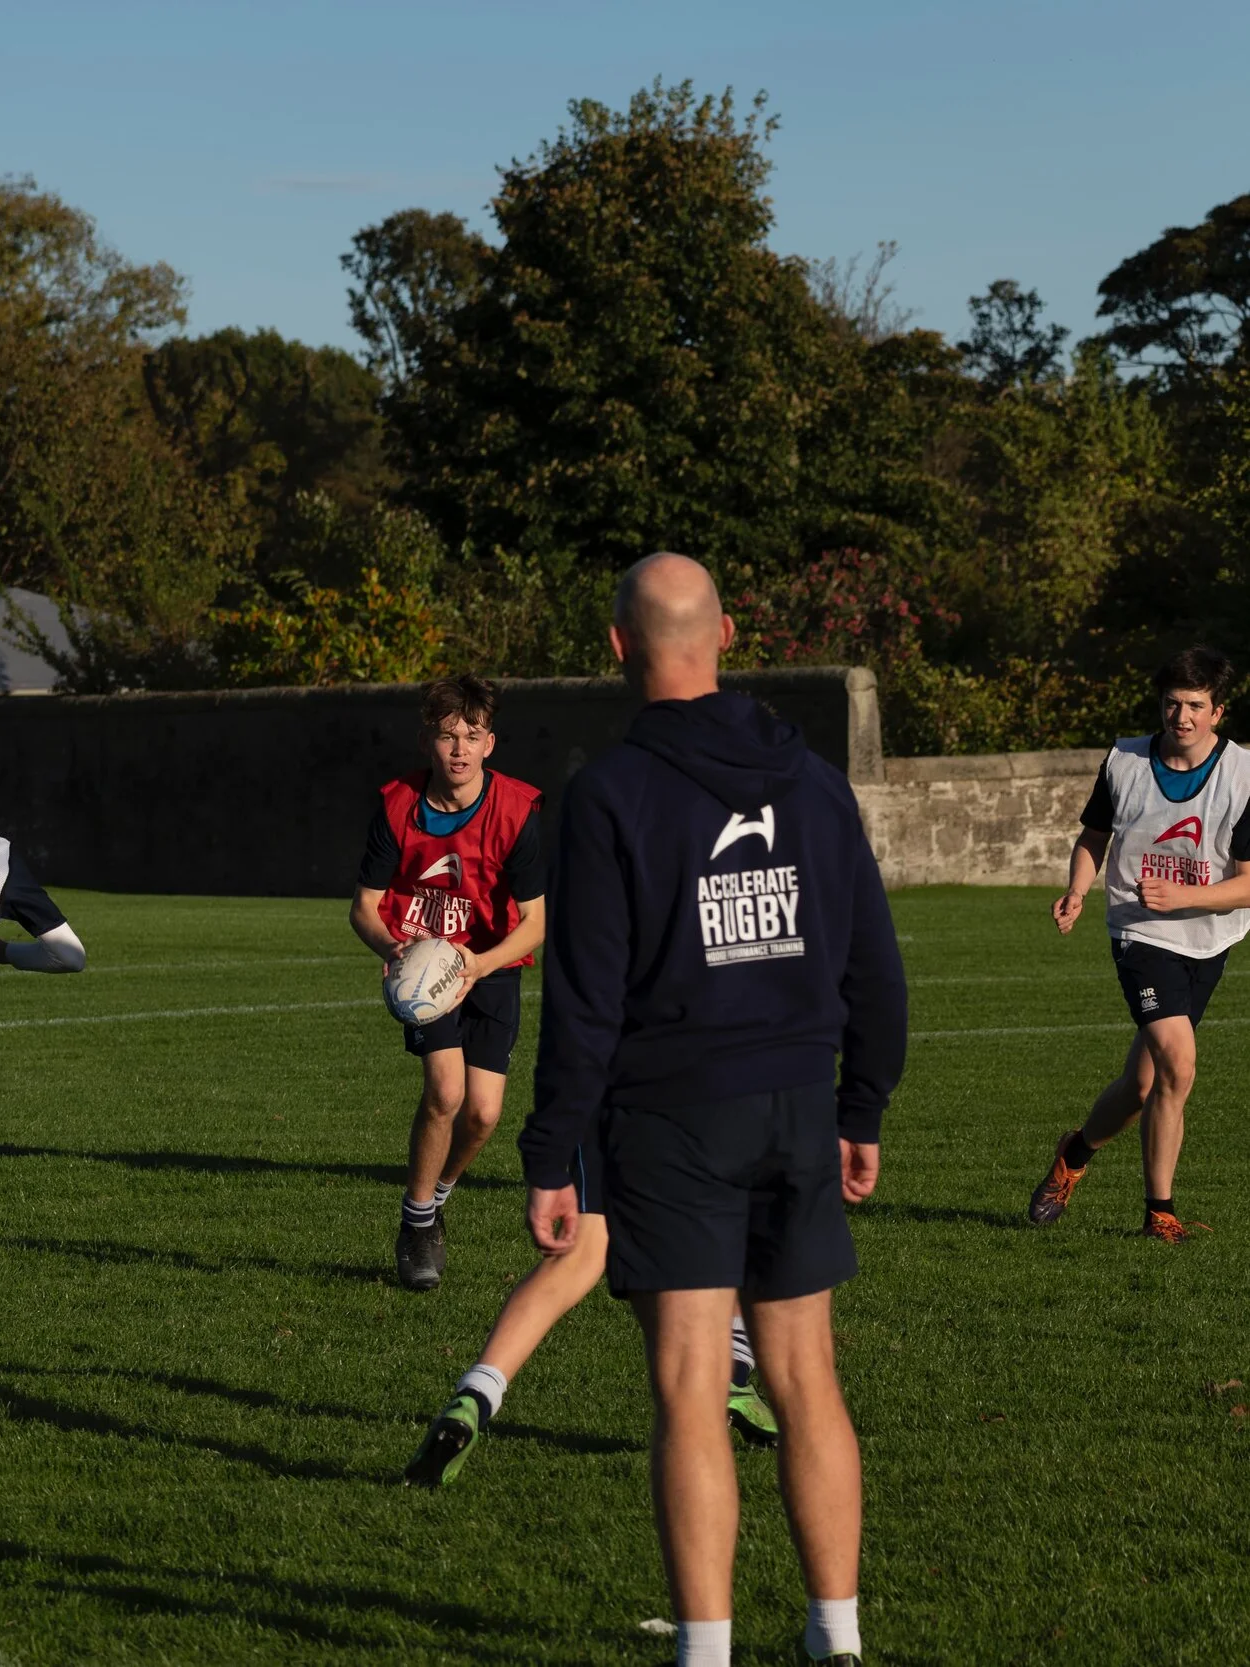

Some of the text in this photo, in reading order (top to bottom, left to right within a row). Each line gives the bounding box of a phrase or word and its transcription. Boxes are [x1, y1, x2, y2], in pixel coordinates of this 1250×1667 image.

[1142, 853, 1211, 874] ACCELERATE
[698, 866, 798, 901] ACCELERATE
[405, 894, 471, 935] RUGBY
[699, 891, 799, 946] RUGBY
[1139, 987, 1156, 998] HR
